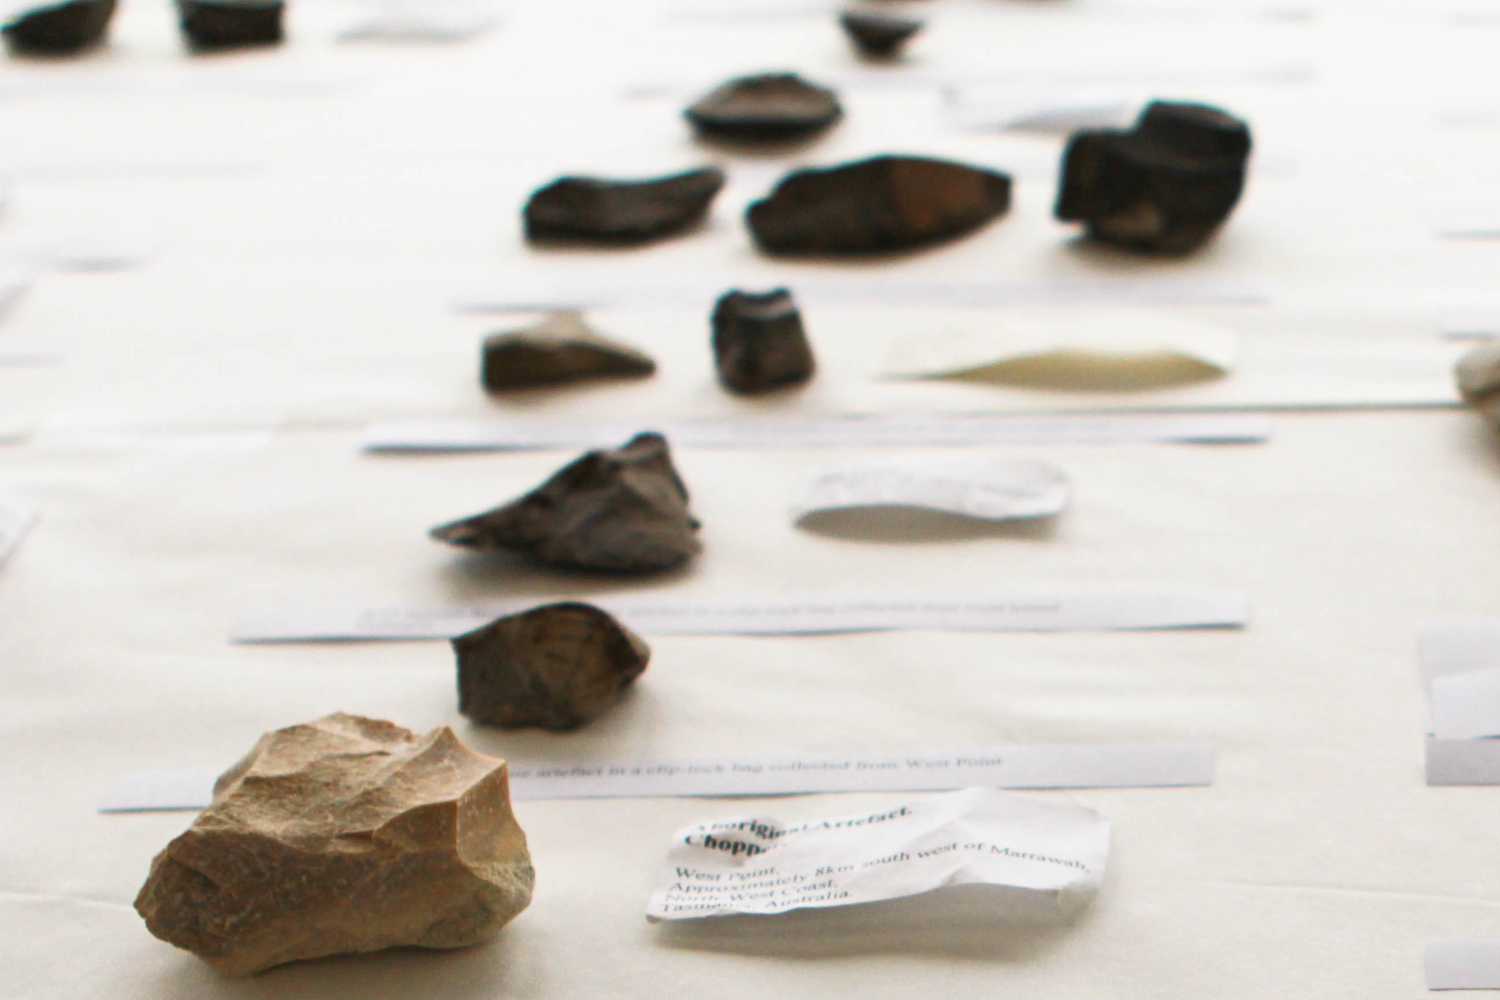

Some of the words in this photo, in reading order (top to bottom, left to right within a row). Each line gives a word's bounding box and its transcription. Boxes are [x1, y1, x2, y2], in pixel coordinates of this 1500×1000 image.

[697, 820, 808, 840] riginal
[685, 834, 788, 857] Chopp
[916, 842, 957, 858] west
